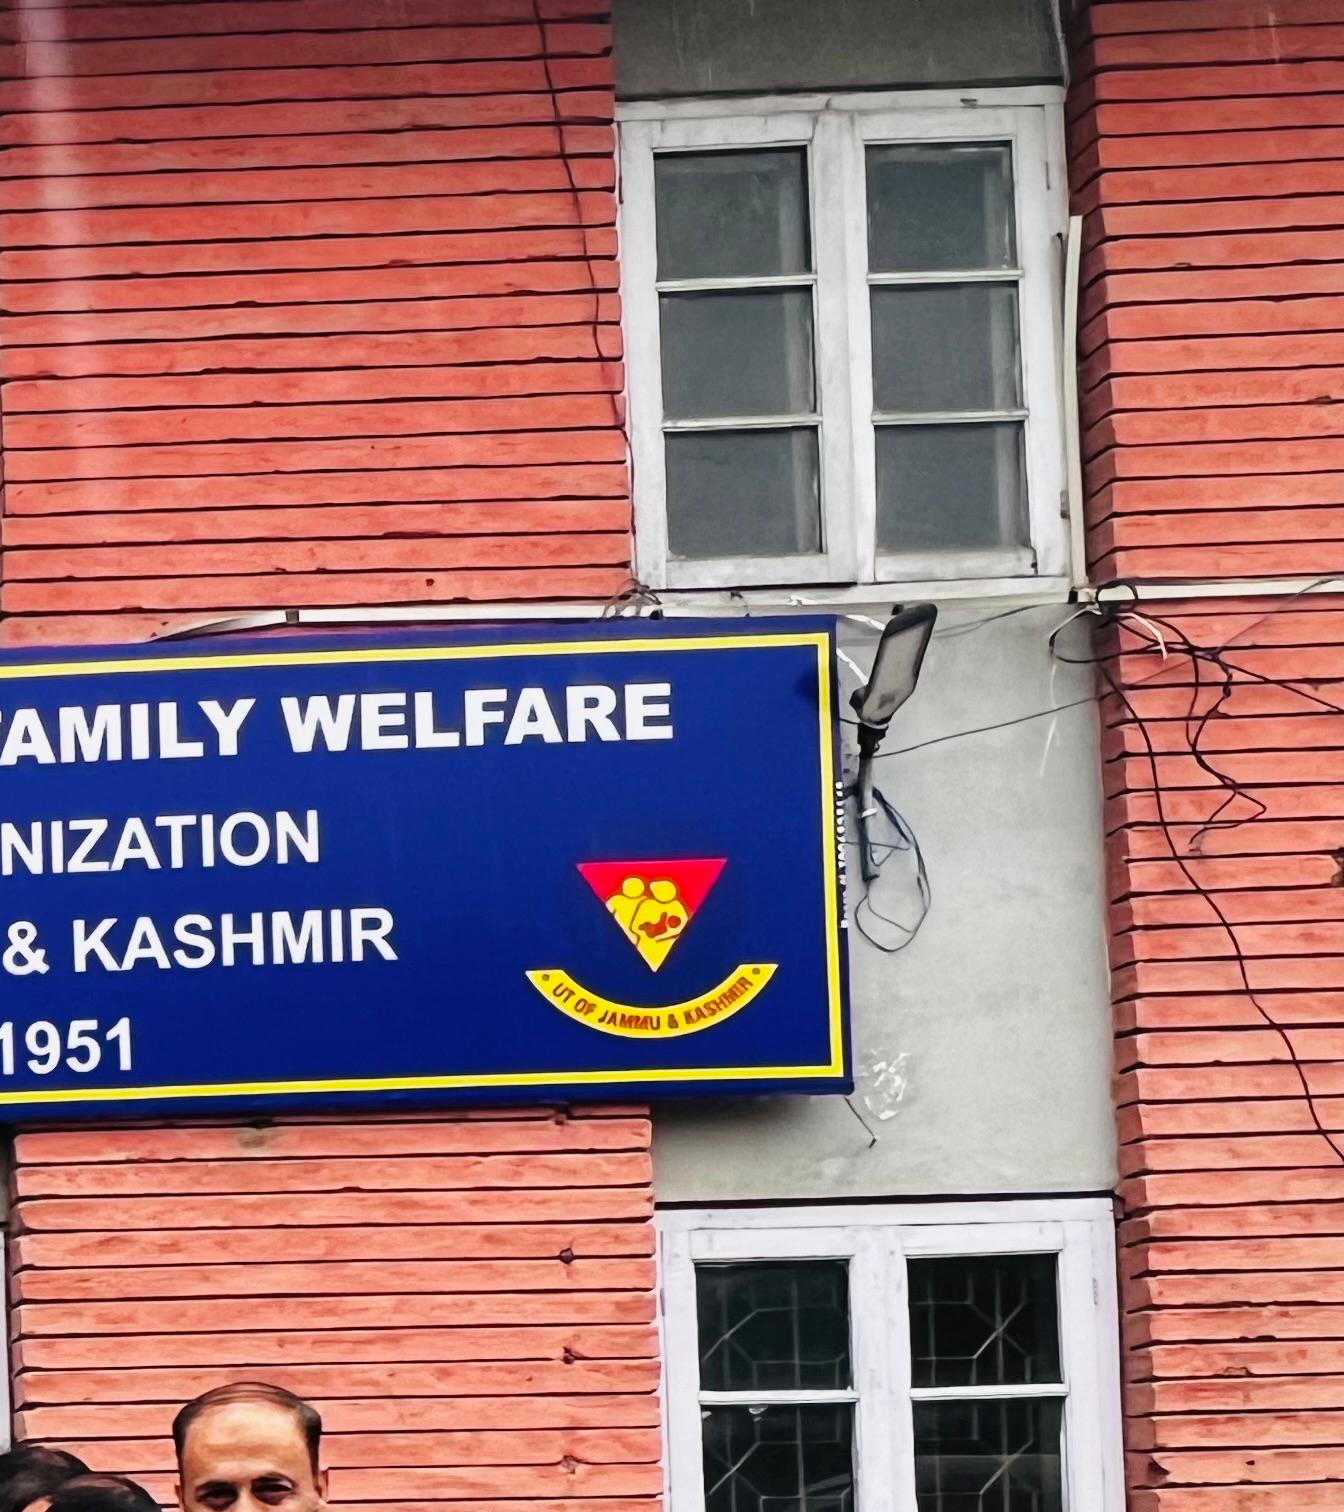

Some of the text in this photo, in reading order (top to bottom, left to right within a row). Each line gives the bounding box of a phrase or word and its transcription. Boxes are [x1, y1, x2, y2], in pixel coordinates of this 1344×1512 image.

[281, 690, 673, 752] WELFARE
[3, 921, 49, 975] &
[73, 908, 397, 972] KASHMIR
[553, 976, 753, 1030] UT OF JAMMU & KASHMIR
